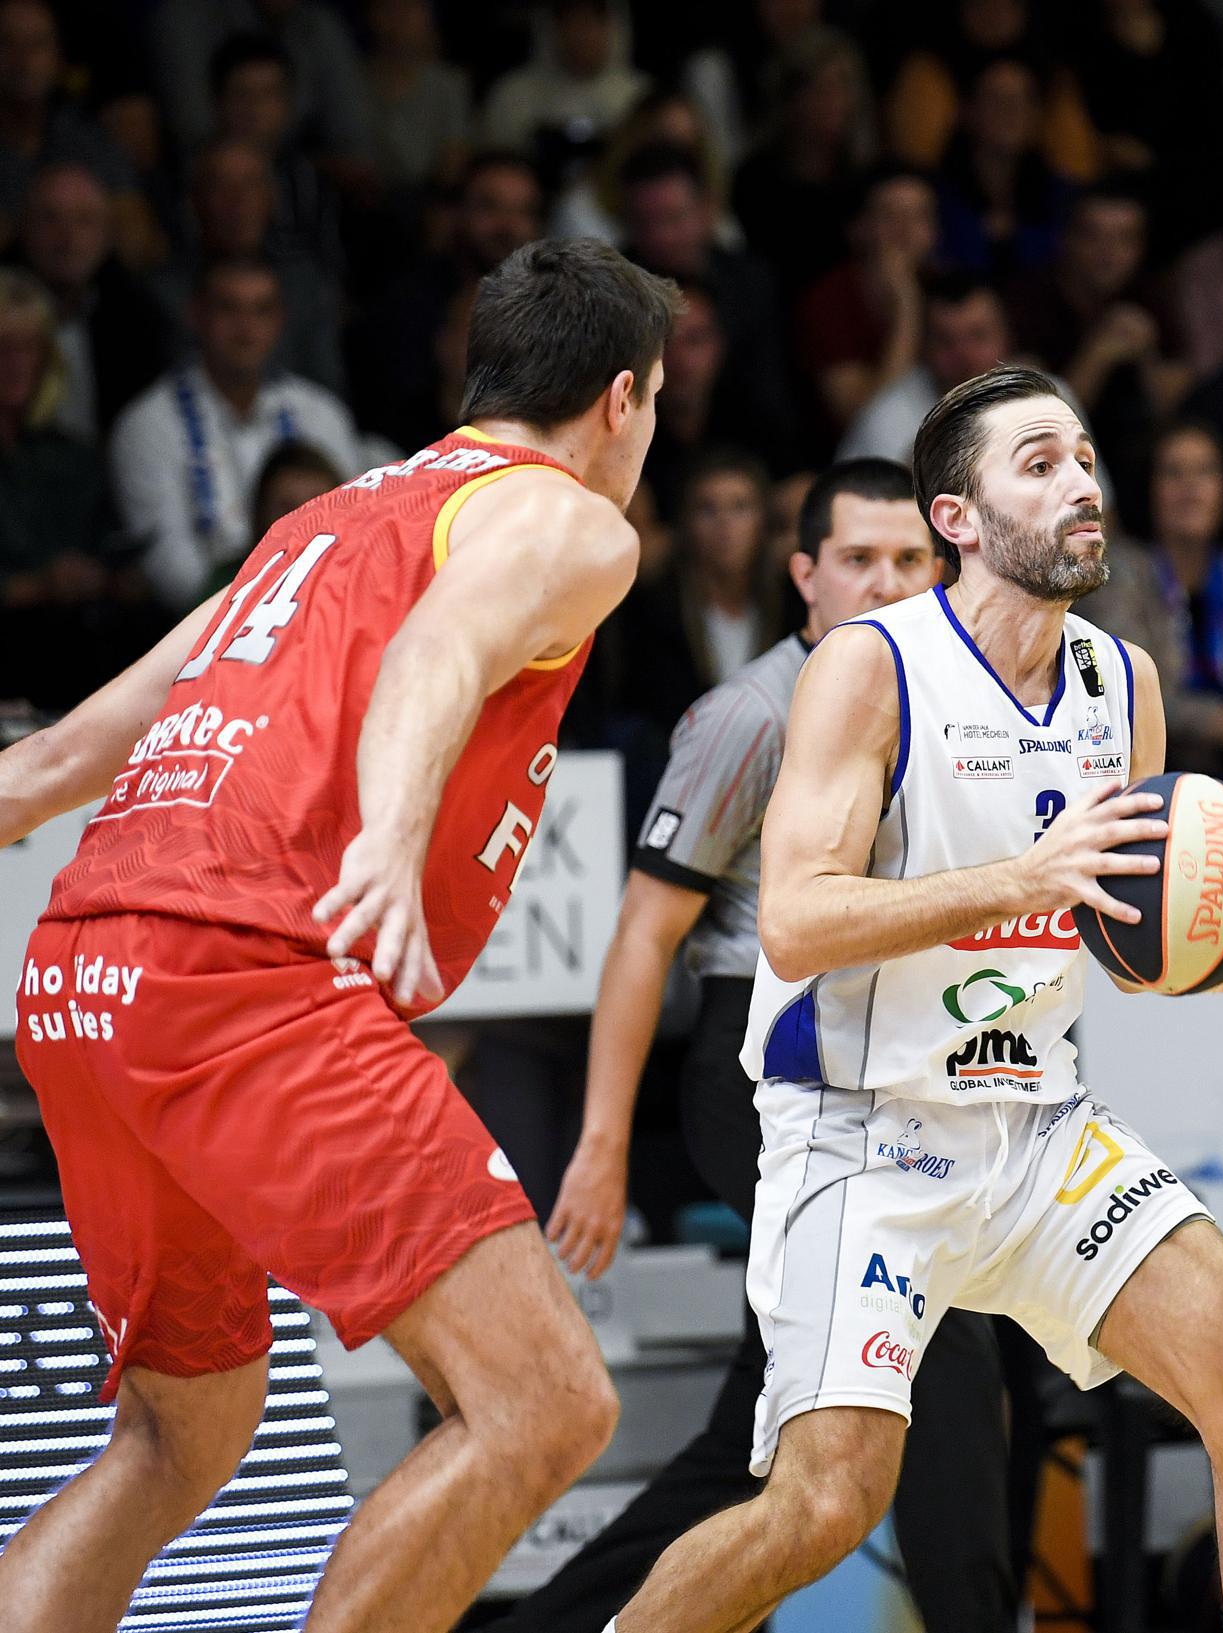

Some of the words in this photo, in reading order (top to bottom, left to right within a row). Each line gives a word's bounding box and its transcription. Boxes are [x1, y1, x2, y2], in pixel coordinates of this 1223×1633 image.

[174, 534, 336, 684] 14
[1018, 738, 1072, 755] SPALDING
[966, 759, 1011, 771] CALLANT
[950, 1078, 992, 1091] GLOBAL
